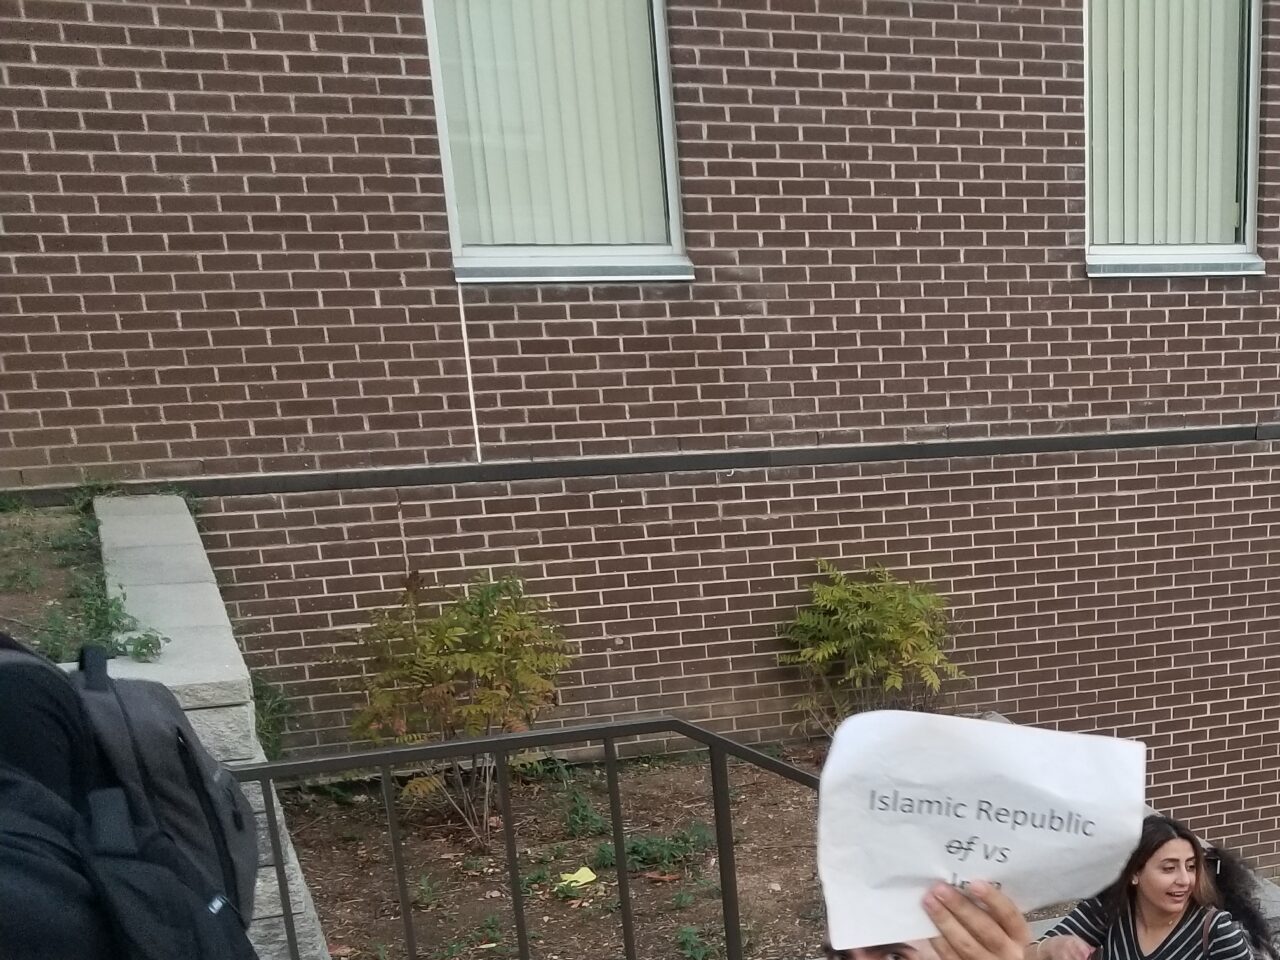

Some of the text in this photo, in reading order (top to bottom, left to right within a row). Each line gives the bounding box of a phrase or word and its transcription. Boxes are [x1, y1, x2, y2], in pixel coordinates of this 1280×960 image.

[868, 789, 1096, 837] Islamic Republic
[982, 843, 1012, 864] vs
